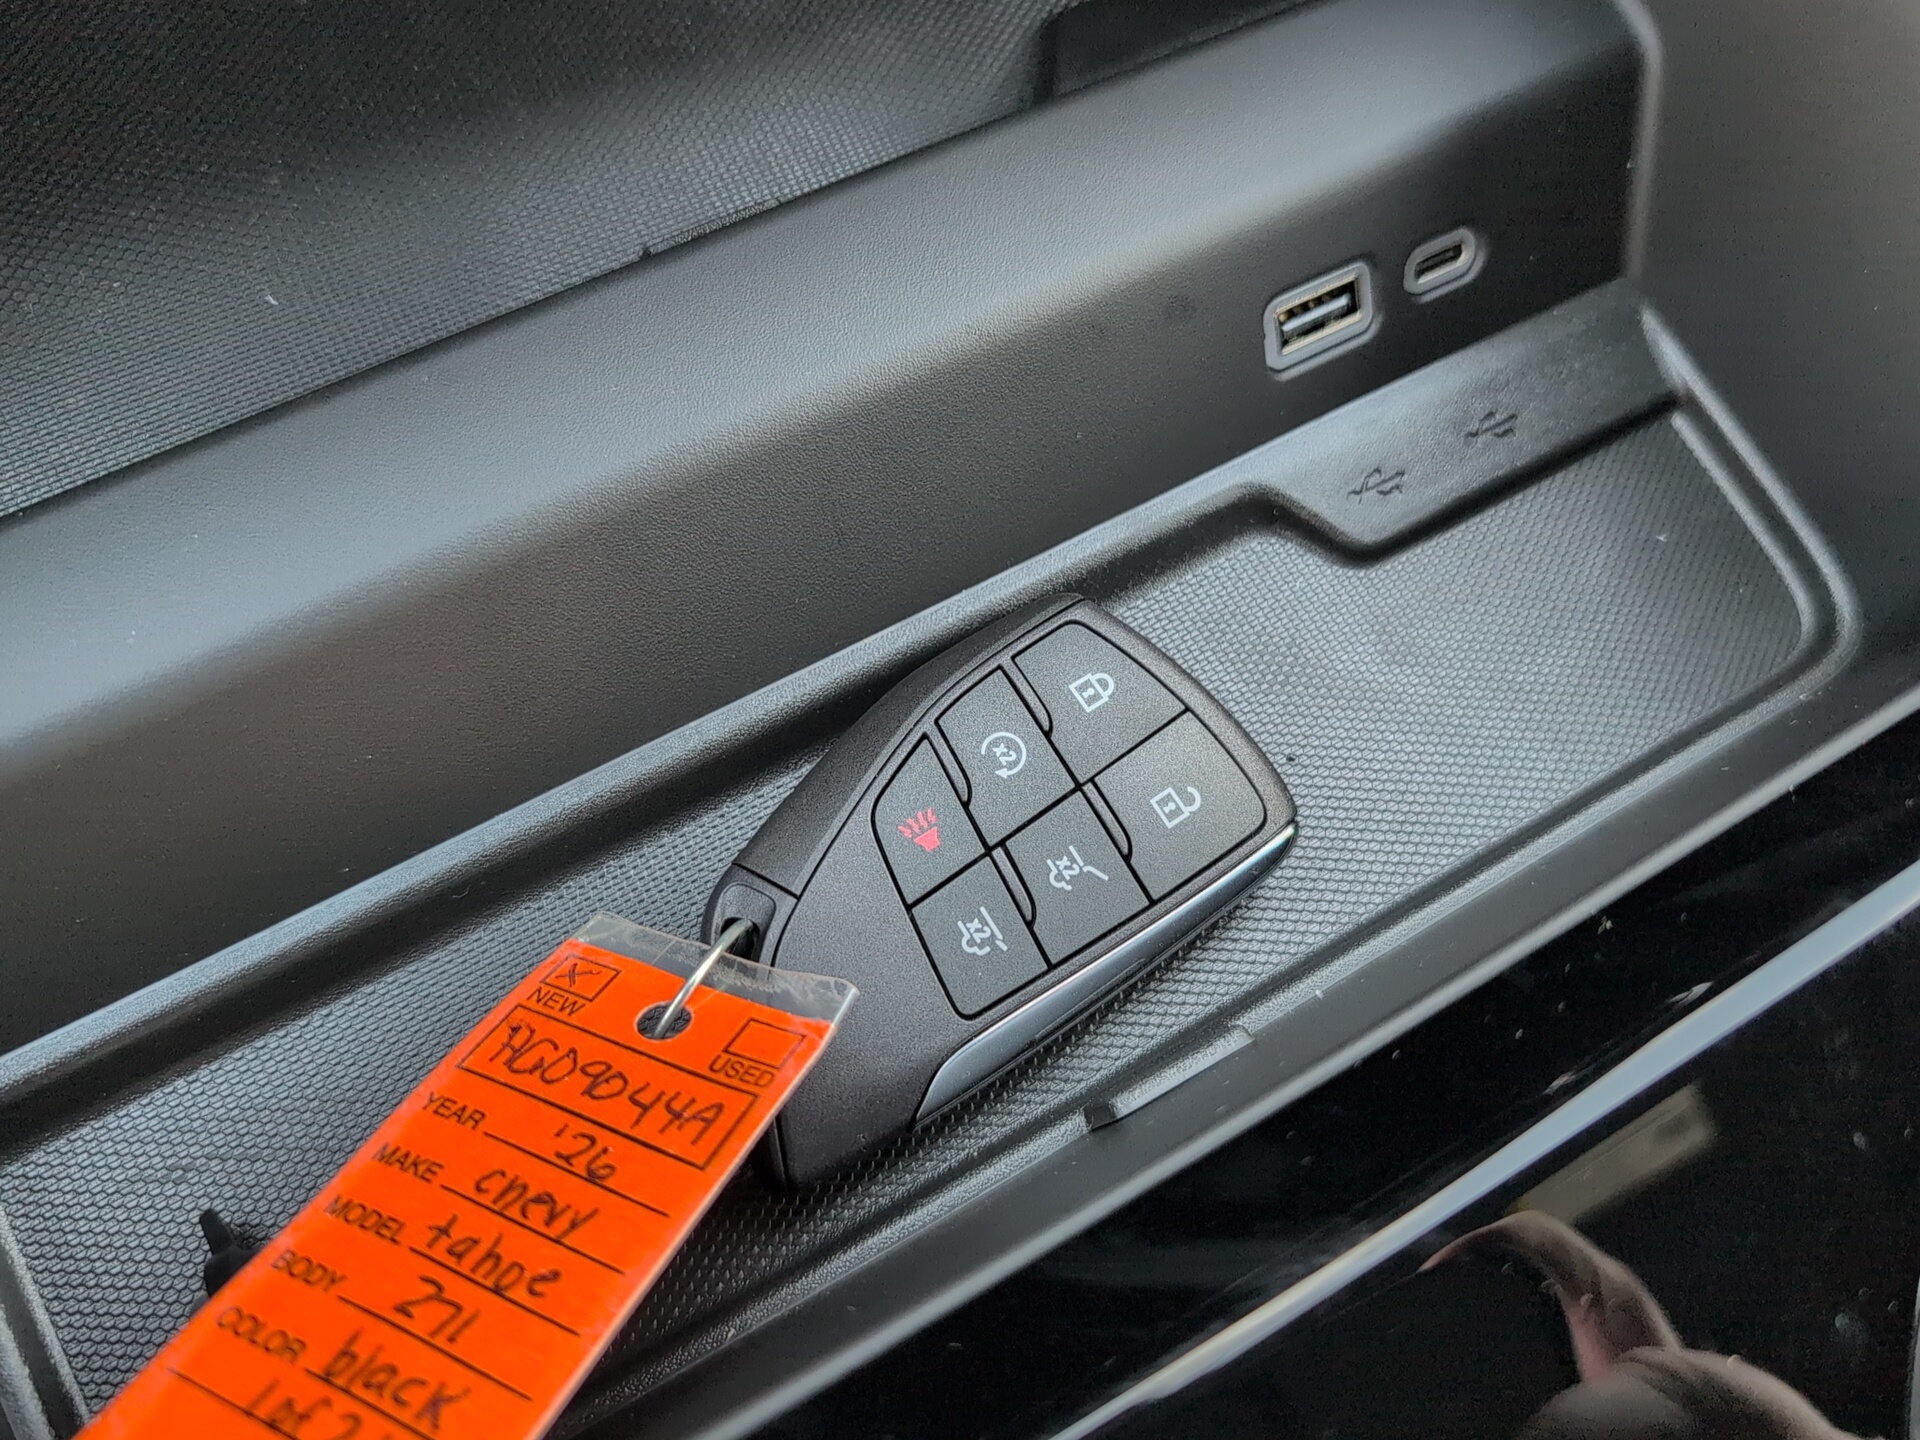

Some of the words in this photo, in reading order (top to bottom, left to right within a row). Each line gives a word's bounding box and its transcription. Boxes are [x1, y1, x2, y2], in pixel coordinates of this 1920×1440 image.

[992, 742, 1017, 766] x2
[1055, 855, 1081, 881] x2
[965, 917, 992, 944] x2
[526, 985, 586, 1017] NEW
[708, 1053, 777, 1089] USED
[420, 1091, 487, 1132] YEAR
[371, 1142, 446, 1184] MAKE
[323, 1194, 406, 1246] MODEL
[270, 1249, 349, 1293] BODY
[426, 1213, 563, 1299] tahoe
[216, 1304, 308, 1366] COLOR
